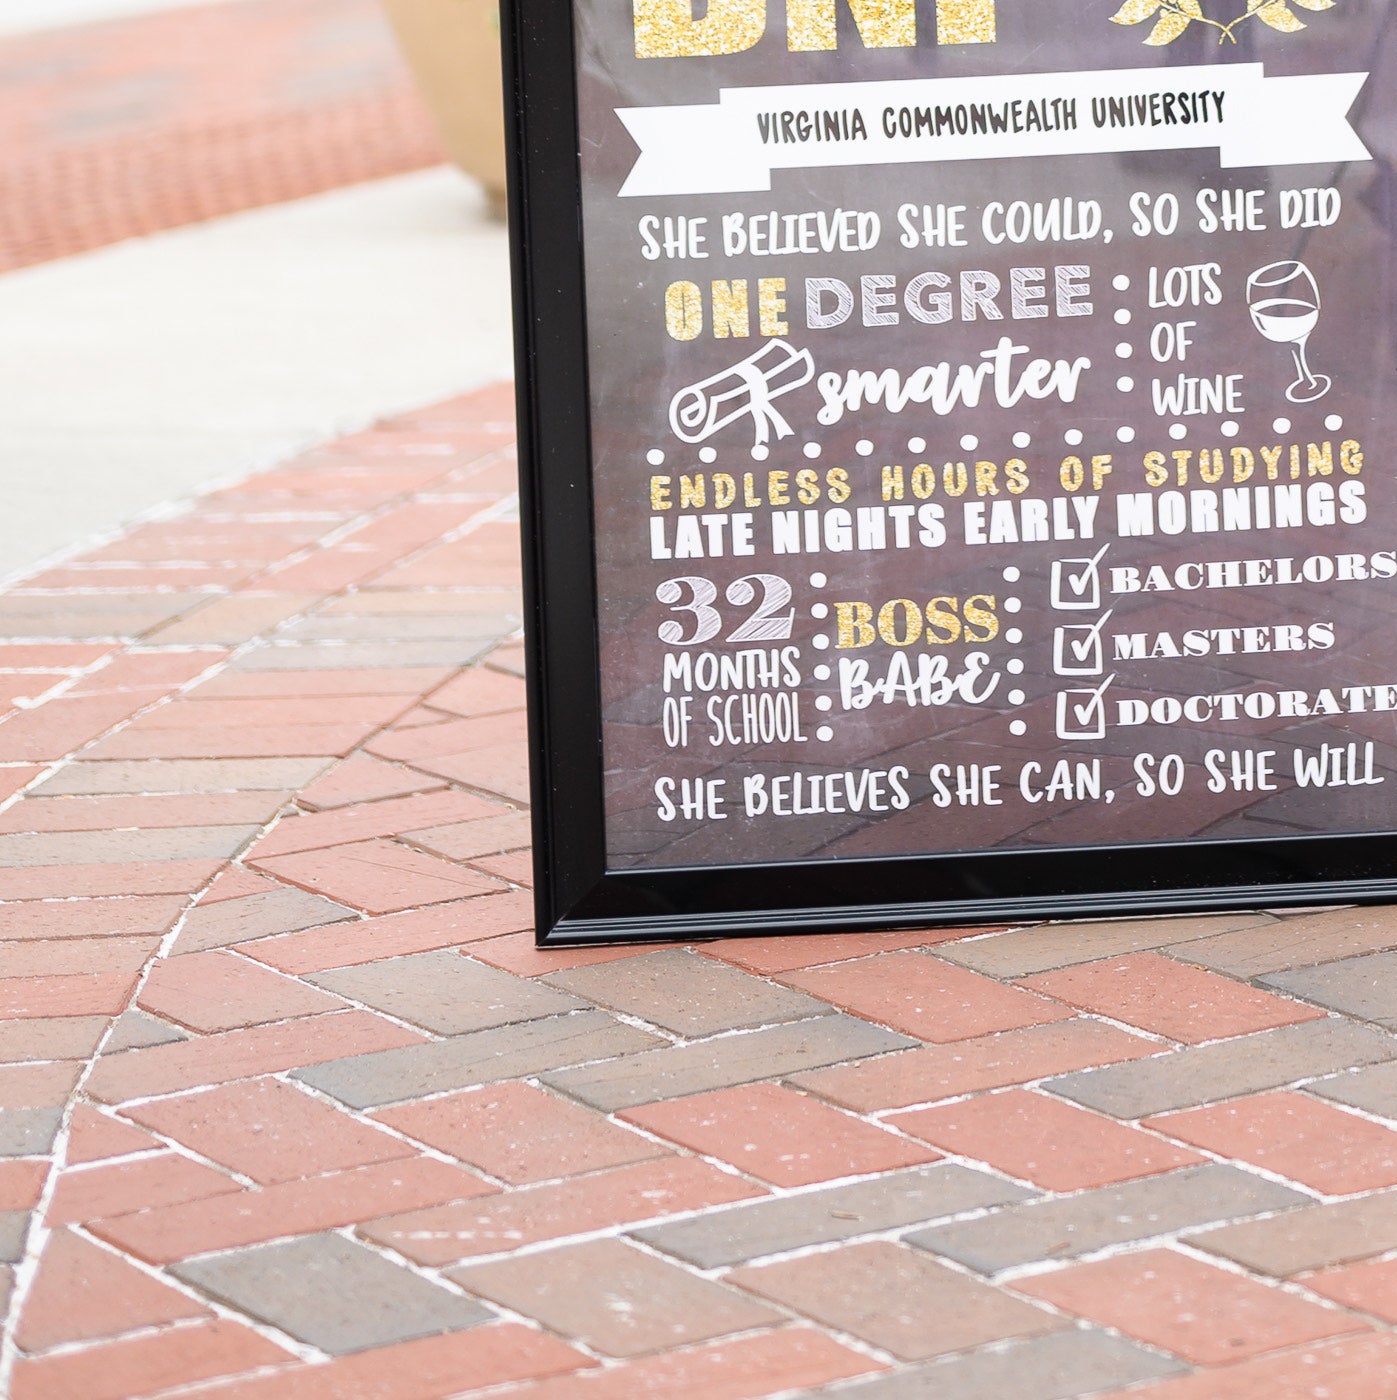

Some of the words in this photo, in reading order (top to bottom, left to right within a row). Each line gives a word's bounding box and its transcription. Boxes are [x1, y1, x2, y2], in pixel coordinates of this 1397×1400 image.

[756, 108, 867, 145] VIRGINIA
[882, 98, 1078, 138] COMMONWEALTH
[1093, 91, 1225, 129] UNIVERSITY
[638, 216, 708, 260] SHE
[723, 209, 880, 257] BELIEVED
[897, 204, 966, 250] SHE
[981, 199, 1113, 246] COULD,
[1130, 194, 1179, 236] SO
[1198, 189, 1264, 233] SHE
[1280, 186, 1341, 229] DID
[664, 278, 787, 341] ONE
[804, 265, 1094, 329] DEGREE
[1148, 263, 1222, 309] LOTS
[1150, 321, 1196, 363] OF
[815, 337, 1091, 426] smarter
[1152, 374, 1244, 417] WINE
[650, 467, 851, 511] ENDLESS
[882, 458, 1030, 501] HOURS
[1060, 453, 1113, 492] OF
[1144, 439, 1366, 487] STUDYING
[650, 509, 754, 559] LATE
[773, 503, 947, 554] NIGHTS
[964, 496, 1100, 545] EARLY
[1117, 481, 1367, 537] MORNINGS
[1109, 550, 1397, 595] BACHELORS
[655, 574, 795, 646] 32
[833, 595, 999, 649] BOSS
[662, 646, 801, 692] MONTHS
[1112, 622, 1336, 660] MASTERS
[838, 653, 1002, 711] BABE
[662, 697, 702, 748] OF
[707, 692, 808, 746] SCHOOL
[655, 776, 724, 821] SHE
[744, 767, 910, 817] BELIEVES
[929, 764, 1001, 806] SHE
[1019, 758, 1114, 803] CAN,
[1133, 753, 1184, 796] SO
[1204, 747, 1275, 792] SHE
[1294, 741, 1384, 787] WILL
